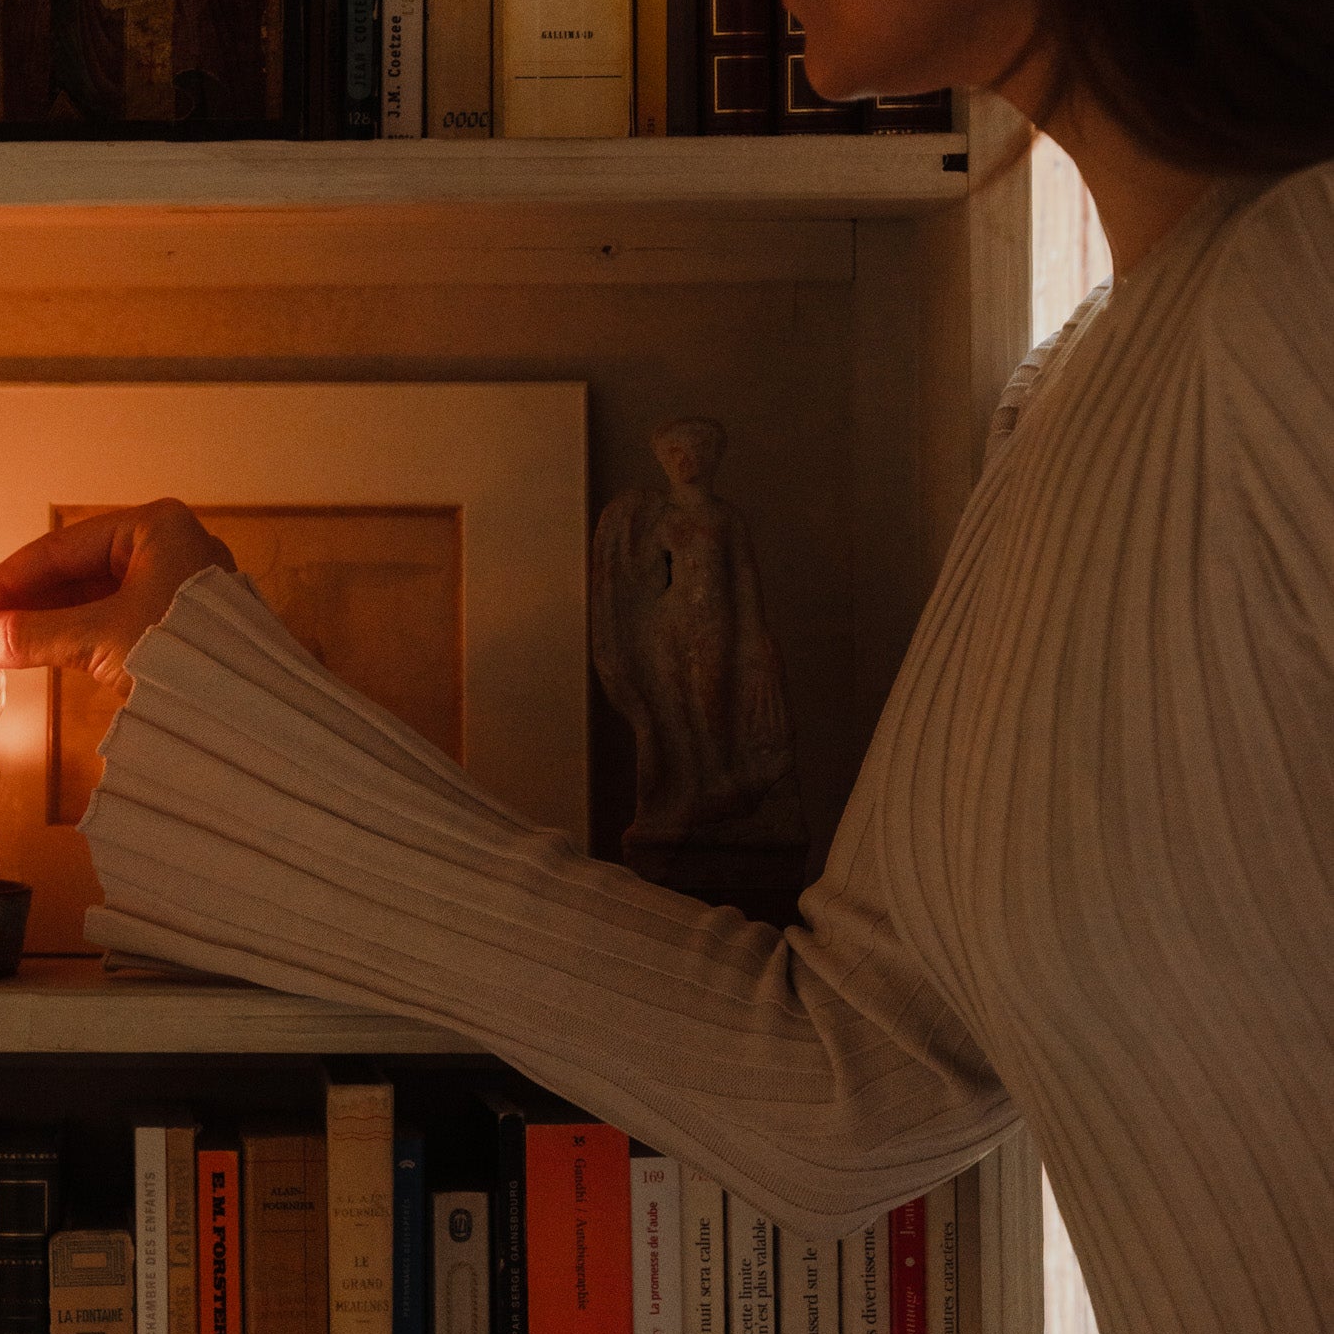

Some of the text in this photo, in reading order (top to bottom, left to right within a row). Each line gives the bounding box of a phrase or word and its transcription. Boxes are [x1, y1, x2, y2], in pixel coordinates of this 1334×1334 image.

[696, 1218, 712, 1263] calme
[804, 1247, 819, 1261] le
[938, 1221, 954, 1293] caractères
[700, 1266, 712, 1297] sera
[809, 1266, 820, 1289] sur
[861, 1226, 878, 1325] divertisseme
[697, 1301, 713, 1333] nuit
